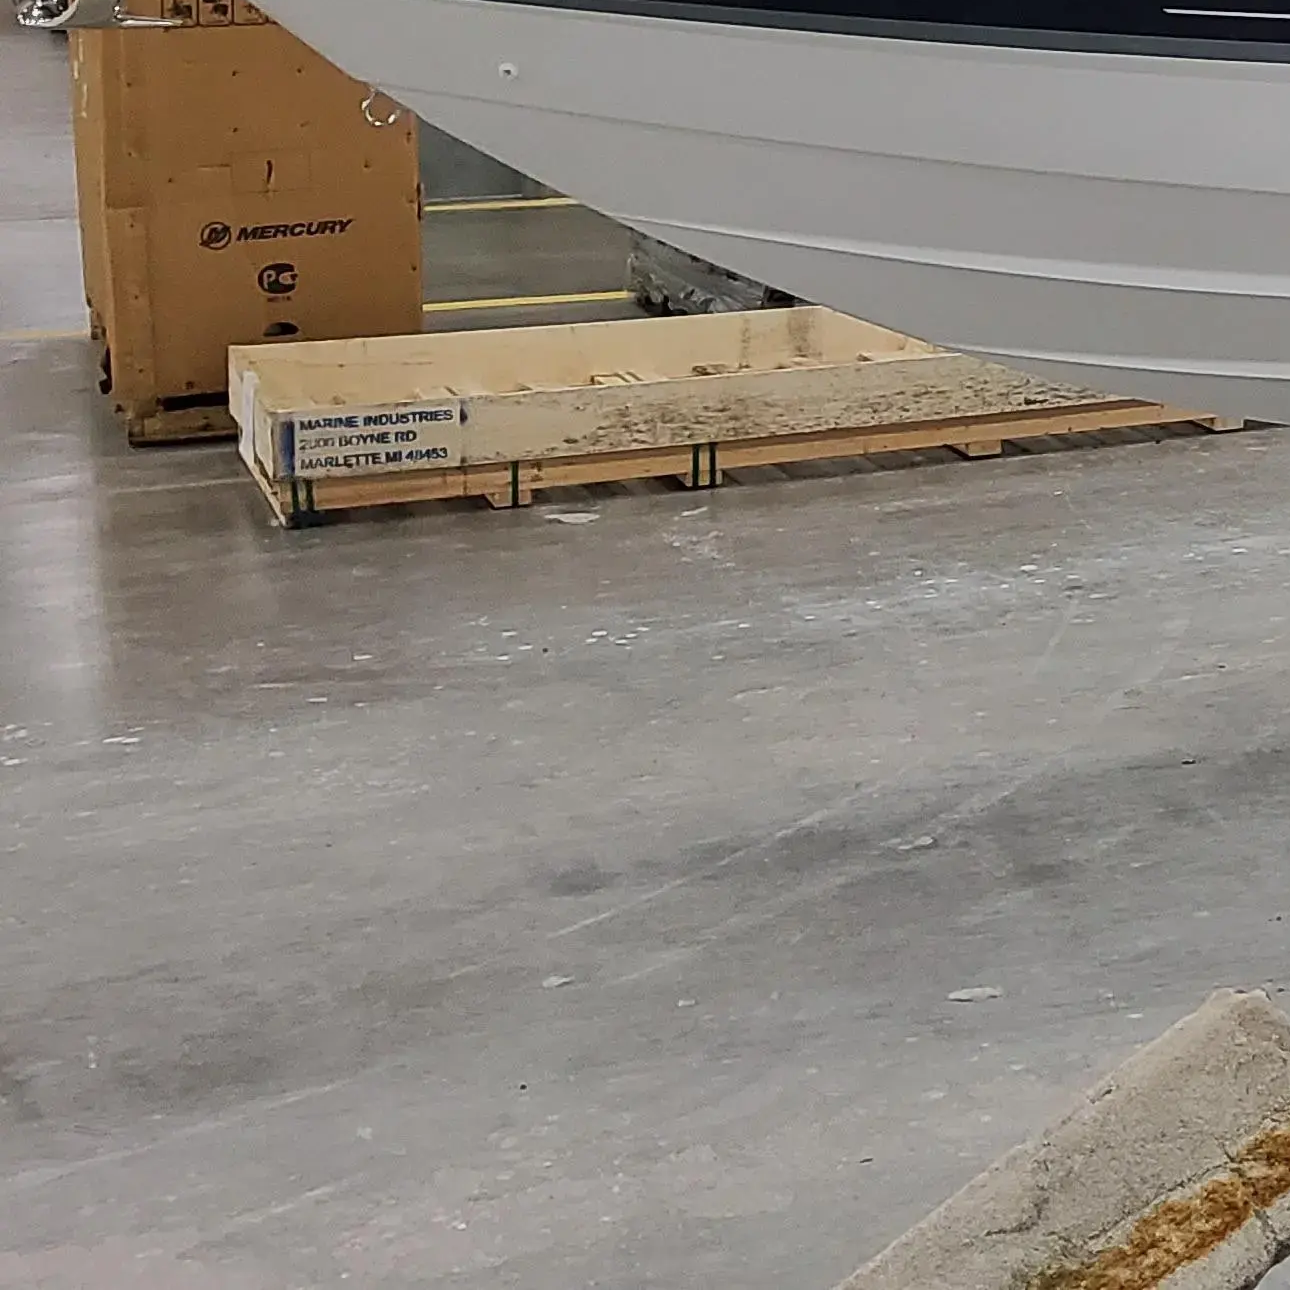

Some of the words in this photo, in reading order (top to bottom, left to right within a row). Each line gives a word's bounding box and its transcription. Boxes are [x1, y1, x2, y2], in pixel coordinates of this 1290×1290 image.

[236, 218, 355, 241] MERCURY
[300, 415, 359, 431] MARINE
[363, 409, 454, 427] INDUSTRIES
[338, 431, 392, 447] BOYNE
[394, 429, 418, 443] RD
[300, 451, 383, 470] MARLETTE
[385, 450, 402, 464] MI
